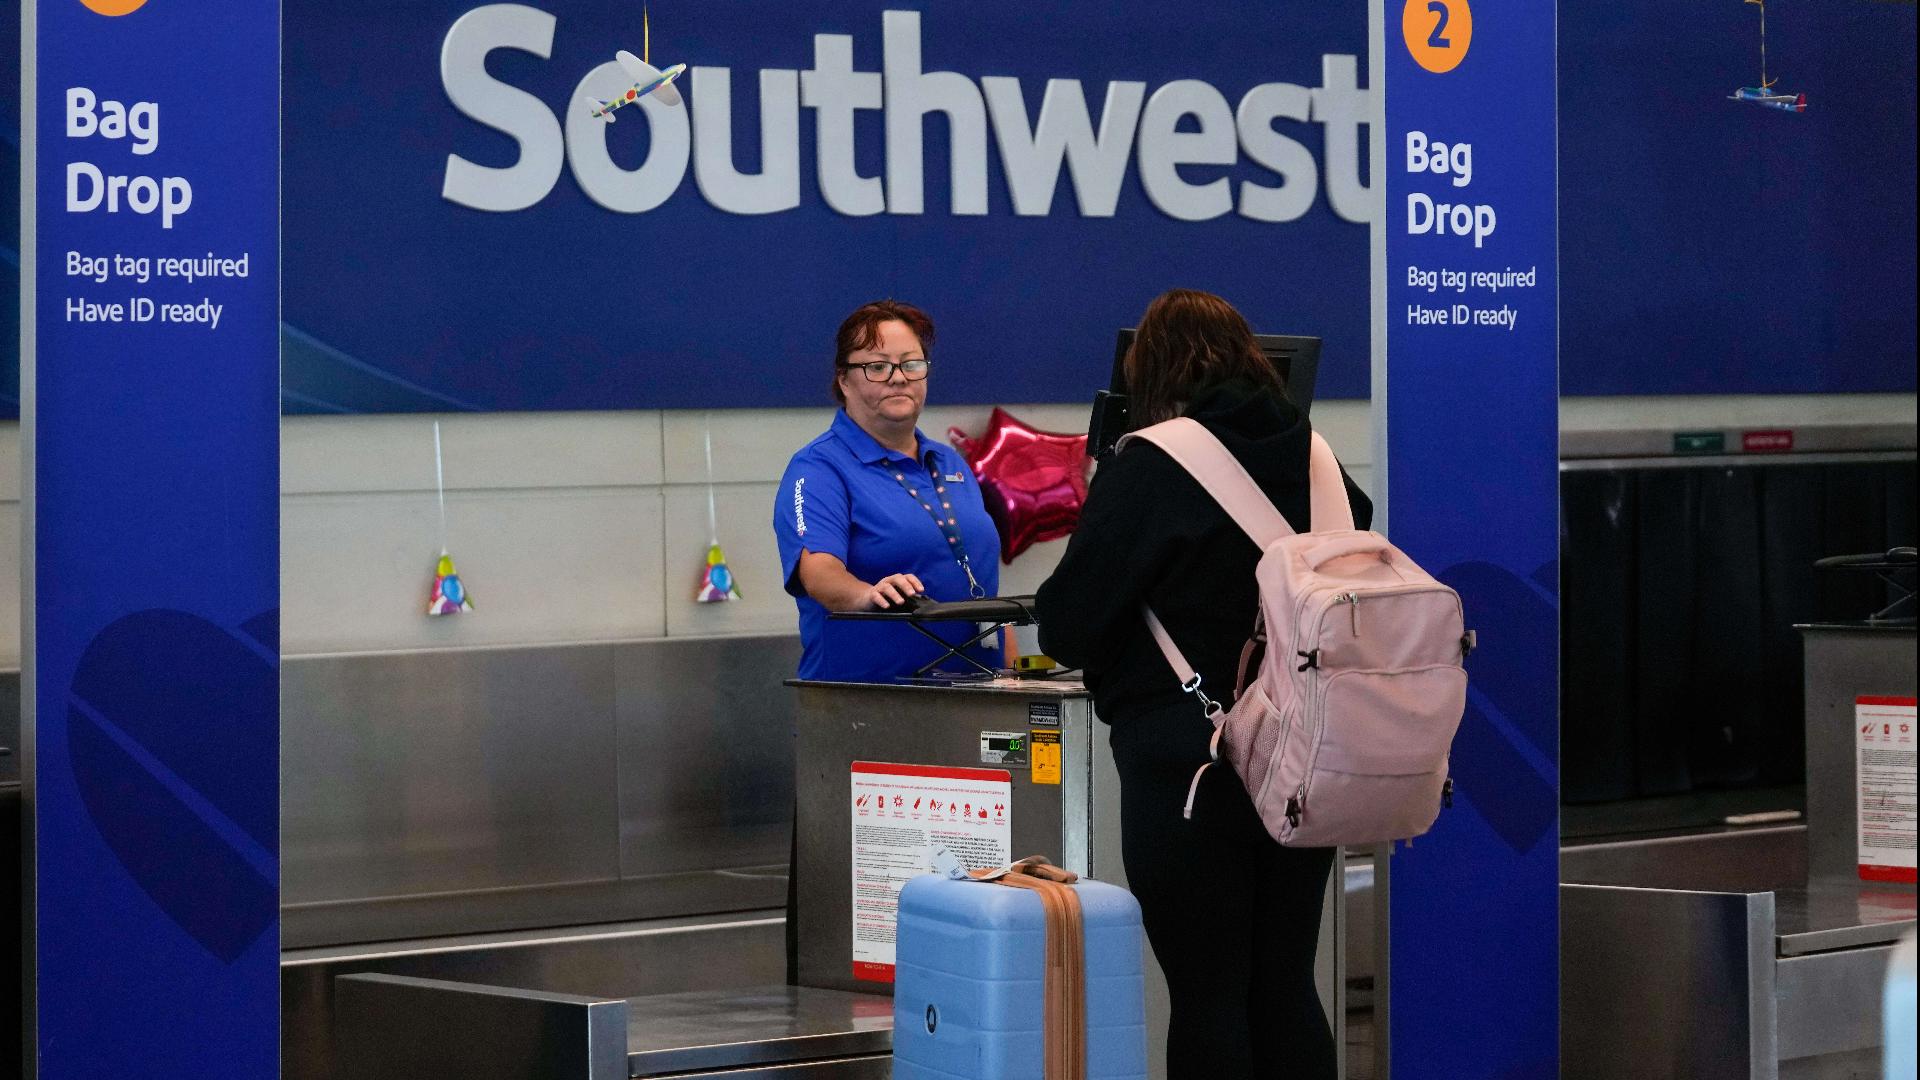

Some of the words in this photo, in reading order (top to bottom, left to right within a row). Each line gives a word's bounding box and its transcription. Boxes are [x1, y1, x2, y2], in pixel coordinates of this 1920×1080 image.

[1427, 1, 1450, 48] 2
[66, 87, 159, 155] Bag
[440, 4, 1370, 224] Southwest
[1406, 131, 1472, 187] Bag
[66, 162, 193, 229] Drop
[1407, 193, 1497, 248] Drop
[66, 251, 109, 283] Bag
[113, 254, 150, 284] tag
[157, 252, 249, 284] required
[1407, 266, 1438, 292] Bag
[1441, 269, 1467, 292] tag
[1470, 266, 1536, 292] required
[66, 298, 124, 322] Have
[130, 298, 155, 322] ID
[161, 298, 223, 330] ready
[1407, 305, 1449, 325] Have
[1452, 305, 1470, 325] ID
[1473, 305, 1518, 331] ready
[794, 477, 807, 531] Southwest
